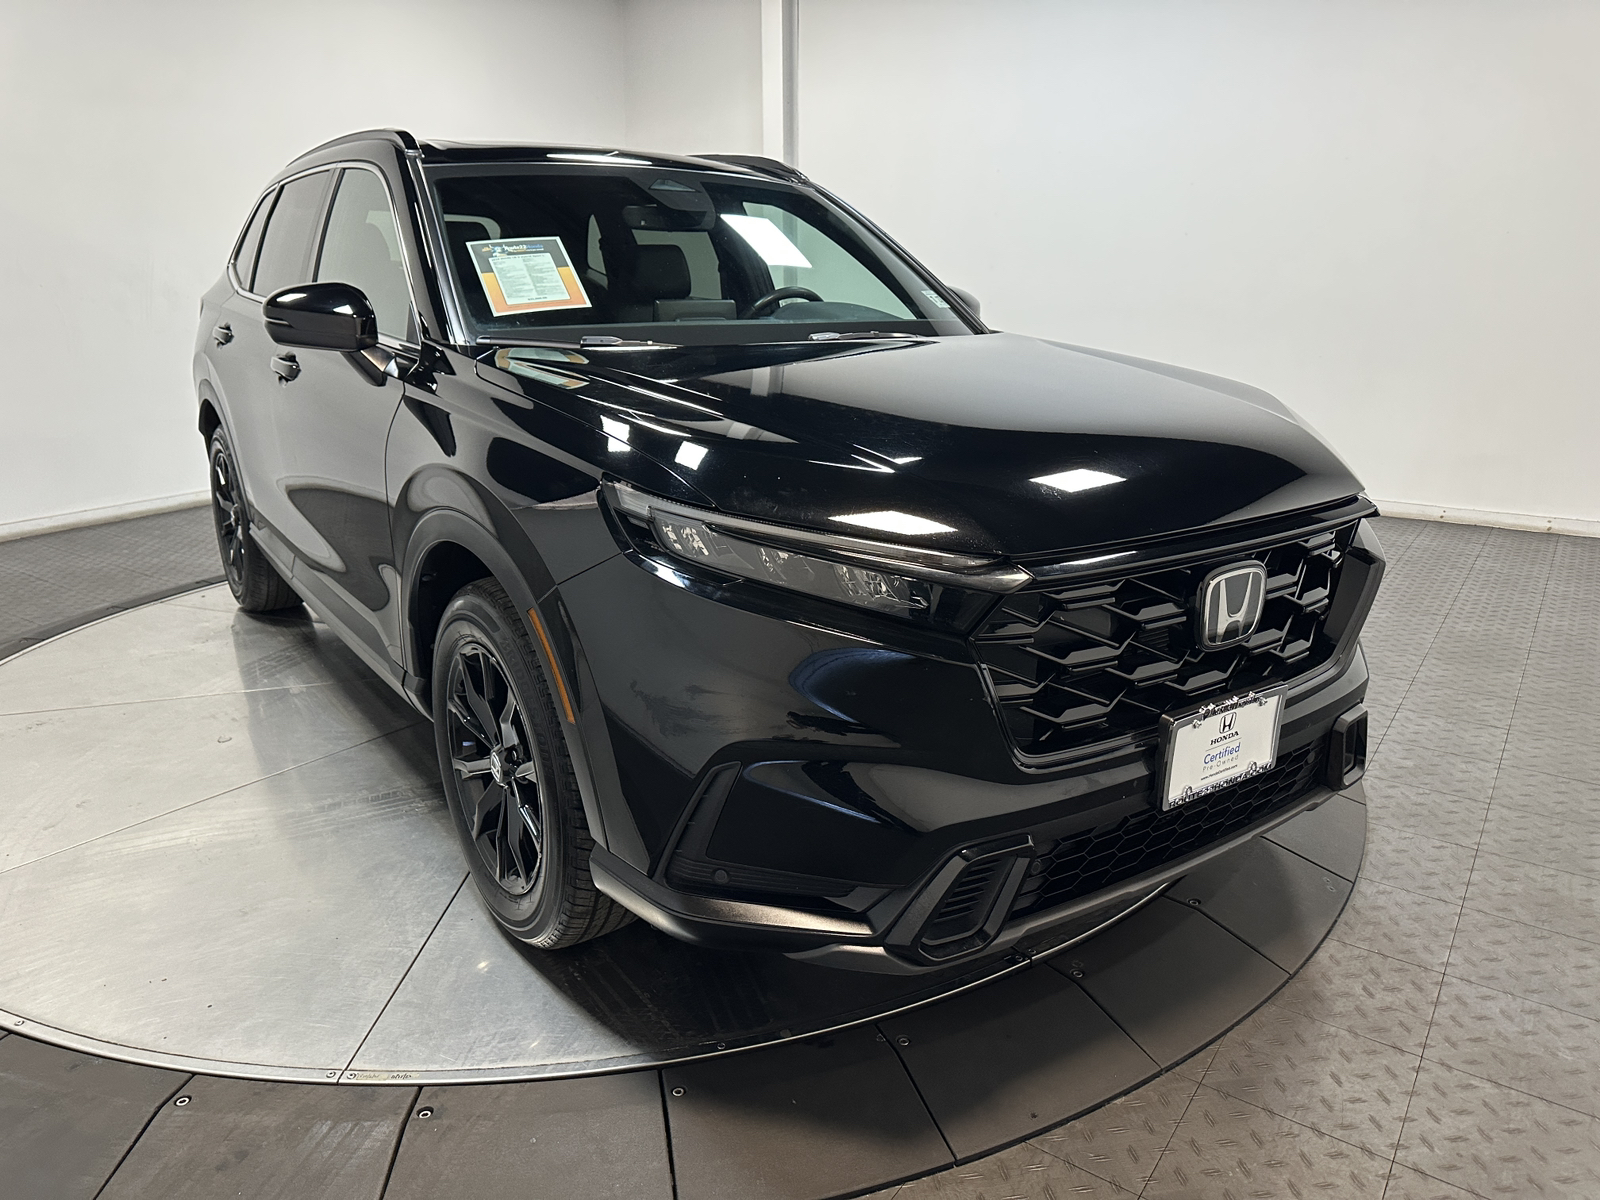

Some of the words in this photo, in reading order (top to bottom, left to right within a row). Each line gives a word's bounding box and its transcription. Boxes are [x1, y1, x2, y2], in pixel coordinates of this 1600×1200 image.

[1210, 730, 1239, 746] HONDA
[1203, 741, 1241, 765] Certified
[1202, 754, 1239, 772] Pre-Owned
